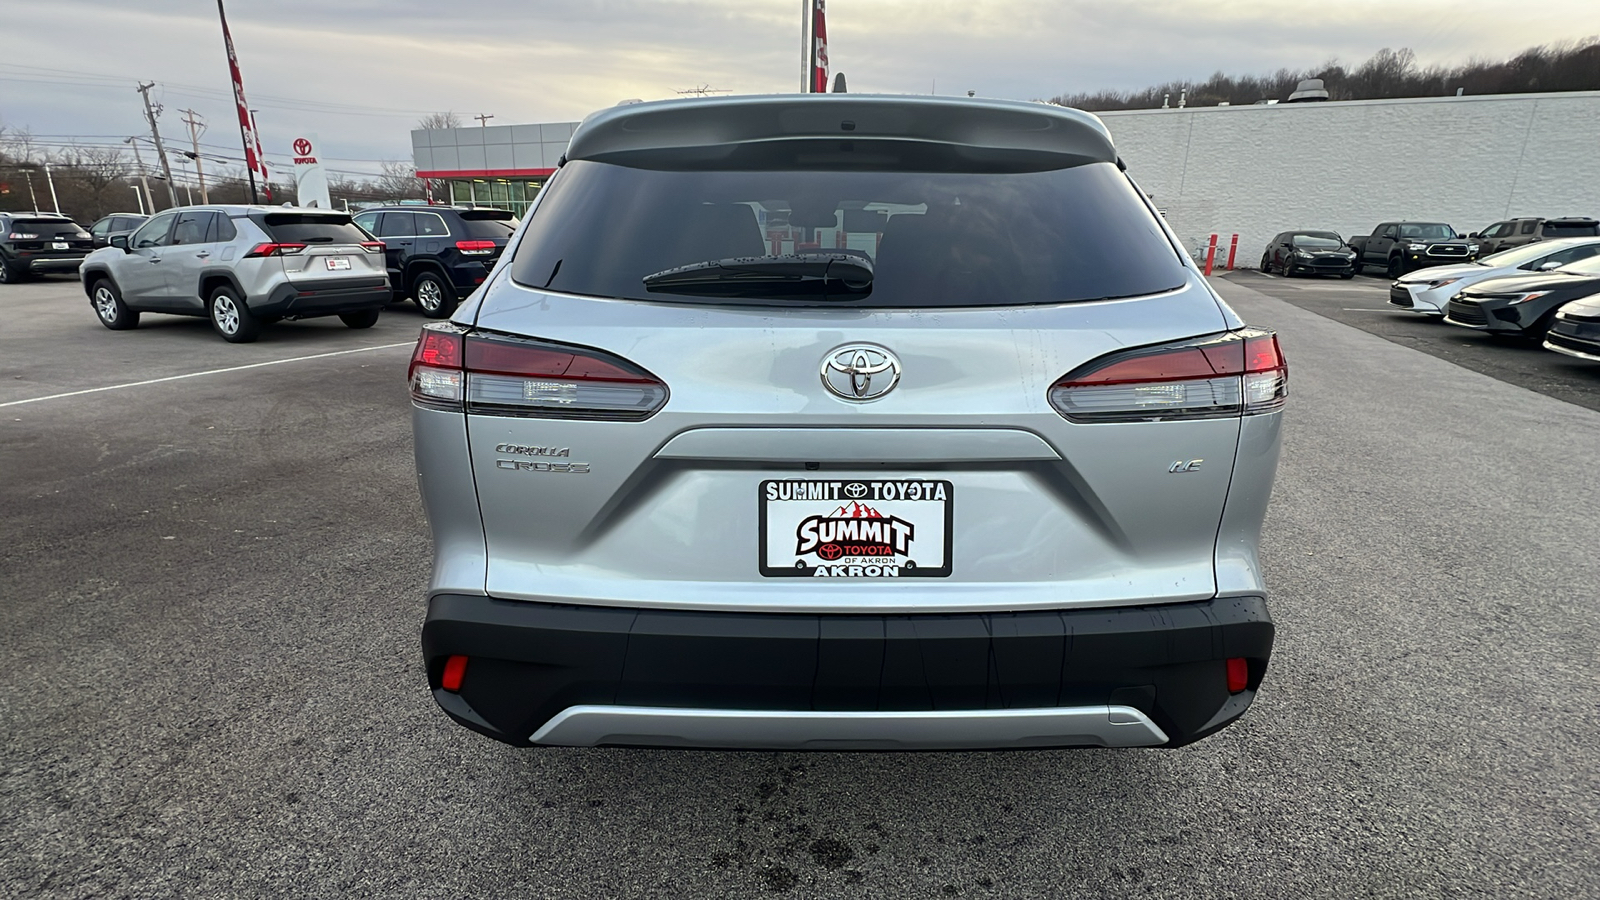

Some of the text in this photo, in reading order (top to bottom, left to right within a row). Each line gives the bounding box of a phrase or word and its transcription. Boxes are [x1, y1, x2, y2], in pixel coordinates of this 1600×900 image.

[293, 157, 318, 165] TOYOTA
[495, 443, 570, 457] COROLLA
[496, 459, 591, 473] CROSS
[1168, 459, 1204, 474] LE
[766, 482, 947, 500] SUMMIT TOYOTA
[800, 518, 911, 553] SUMMIT
[844, 545, 893, 556] TOYOTA
[813, 565, 899, 577] AKRON
